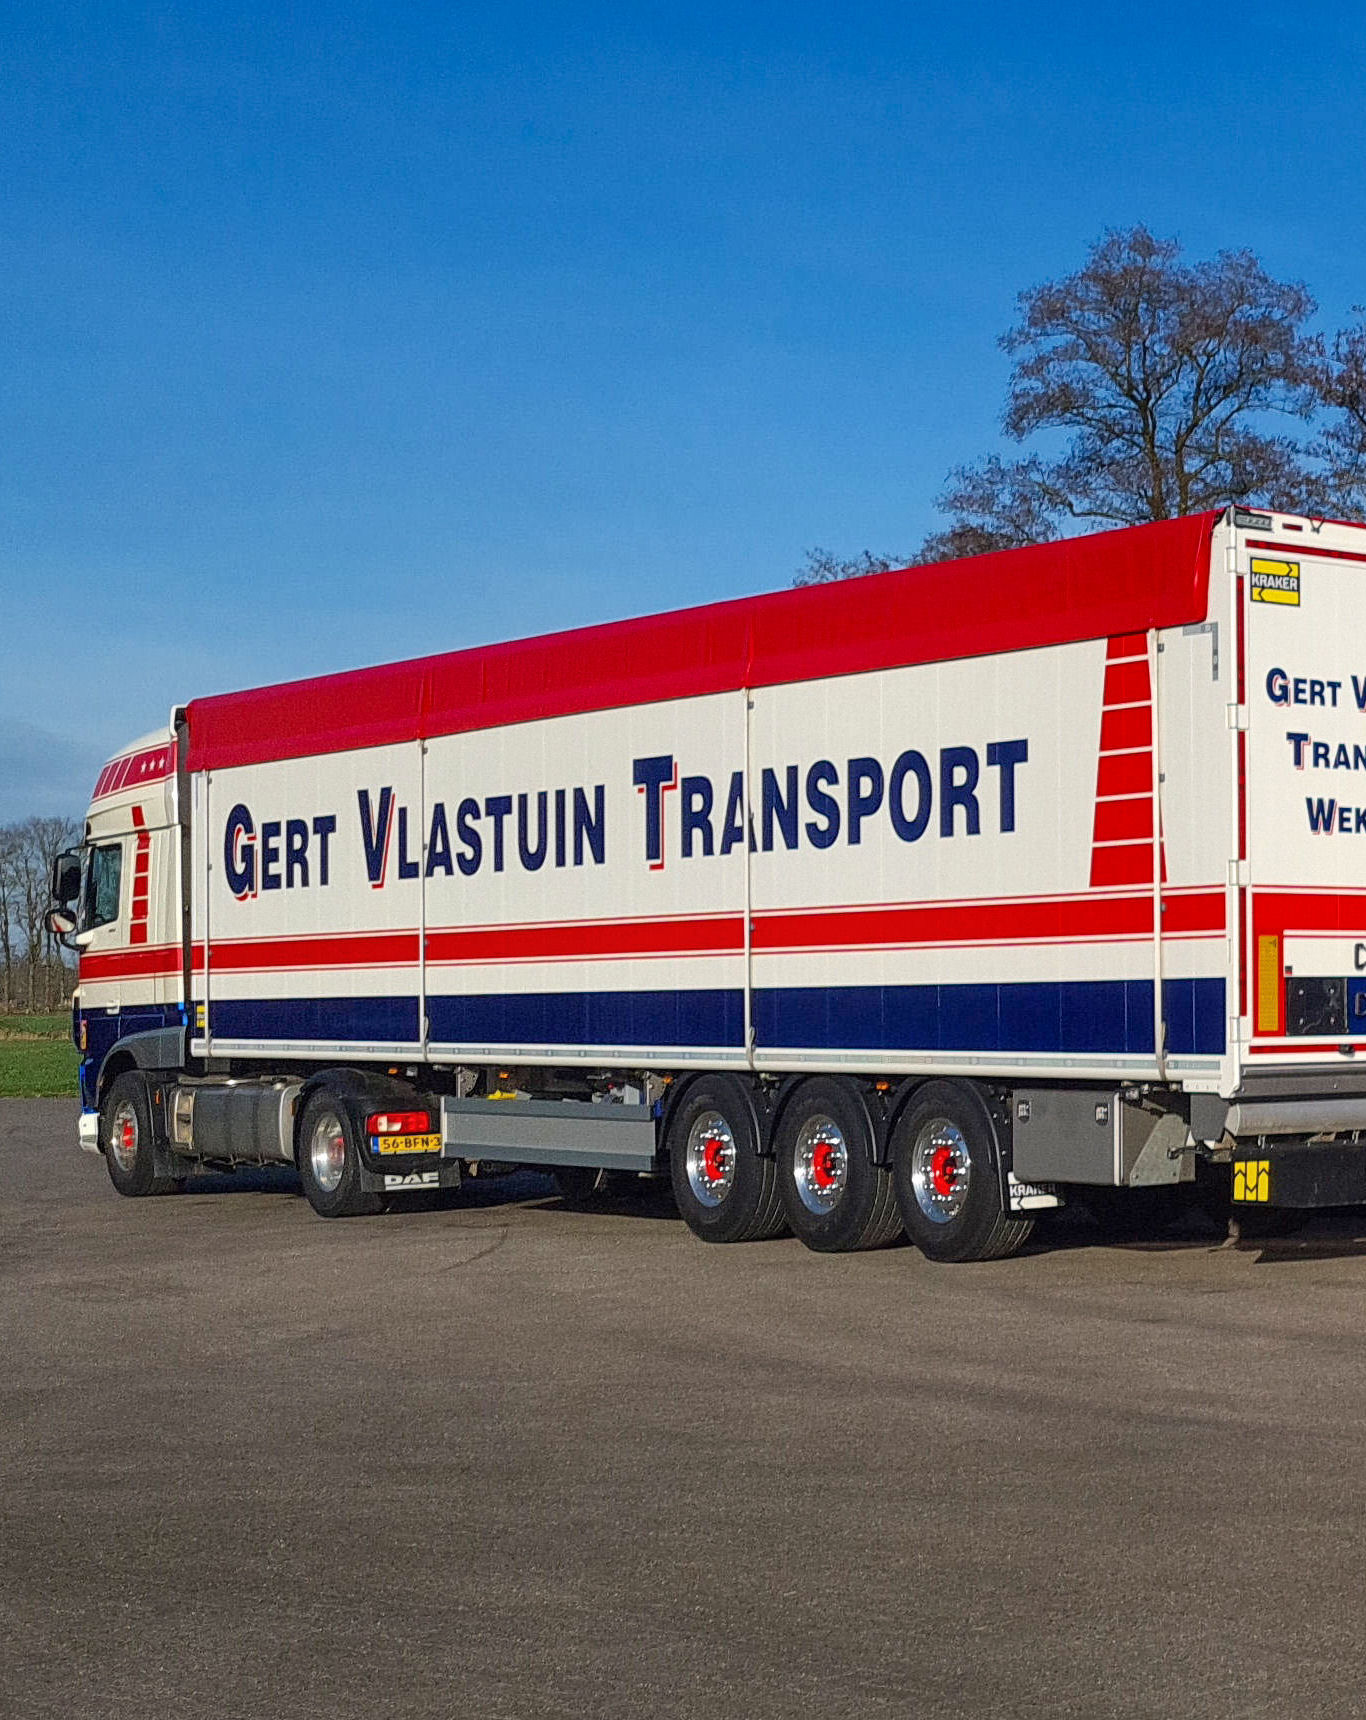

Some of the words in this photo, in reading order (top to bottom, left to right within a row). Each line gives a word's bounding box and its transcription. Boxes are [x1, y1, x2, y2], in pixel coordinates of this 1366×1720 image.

[1251, 573, 1298, 591] KRAKER
[1265, 667, 1342, 707] GERT
[224, 803, 337, 901] GERT
[356, 784, 606, 889] VLASTUIN
[632, 738, 1029, 870] TRANSPORT
[384, 1171, 439, 1186] DAF
